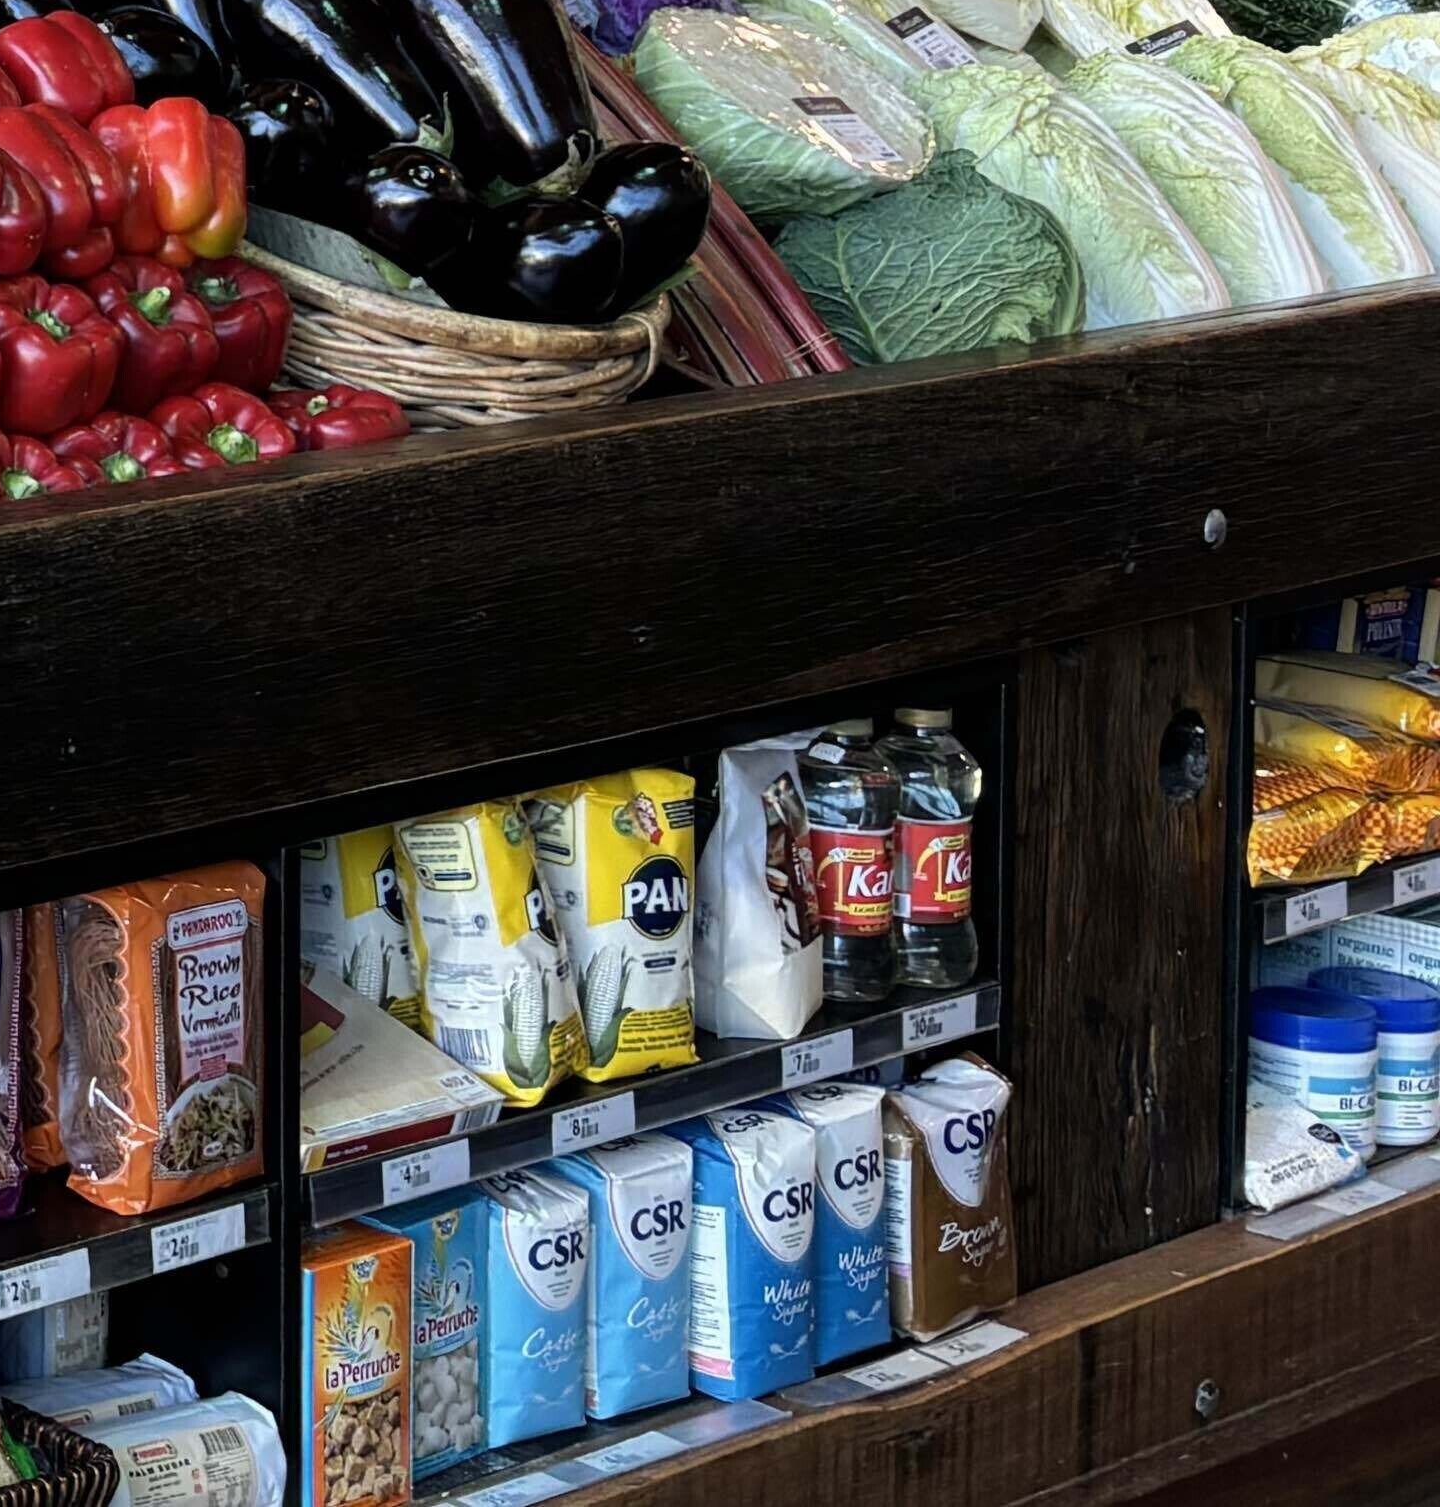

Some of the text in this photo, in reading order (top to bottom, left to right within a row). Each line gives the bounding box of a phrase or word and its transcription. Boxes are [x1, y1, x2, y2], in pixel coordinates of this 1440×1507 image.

[624, 877, 688, 920] PAN
[181, 912, 233, 938] PANDAROO
[1336, 935, 1394, 958] organic
[179, 954, 240, 983] Brown
[180, 982, 240, 1010] Rice
[181, 1002, 240, 1034] Vermicelli
[722, 1113, 775, 1134] CSR
[944, 1109, 996, 1155] CSR
[834, 1149, 882, 1192] CSR
[762, 1181, 813, 1223] CSR
[630, 1199, 685, 1241] CSR
[938, 1216, 1003, 1252] Brown
[529, 1230, 585, 1272] CSR
[839, 1244, 884, 1270] White
[764, 1278, 811, 1304] White
[849, 1266, 880, 1291] Sugar
[427, 1305, 479, 1338] Perruche
[774, 1301, 808, 1326] Sugar
[340, 1351, 401, 1384] Perruche
